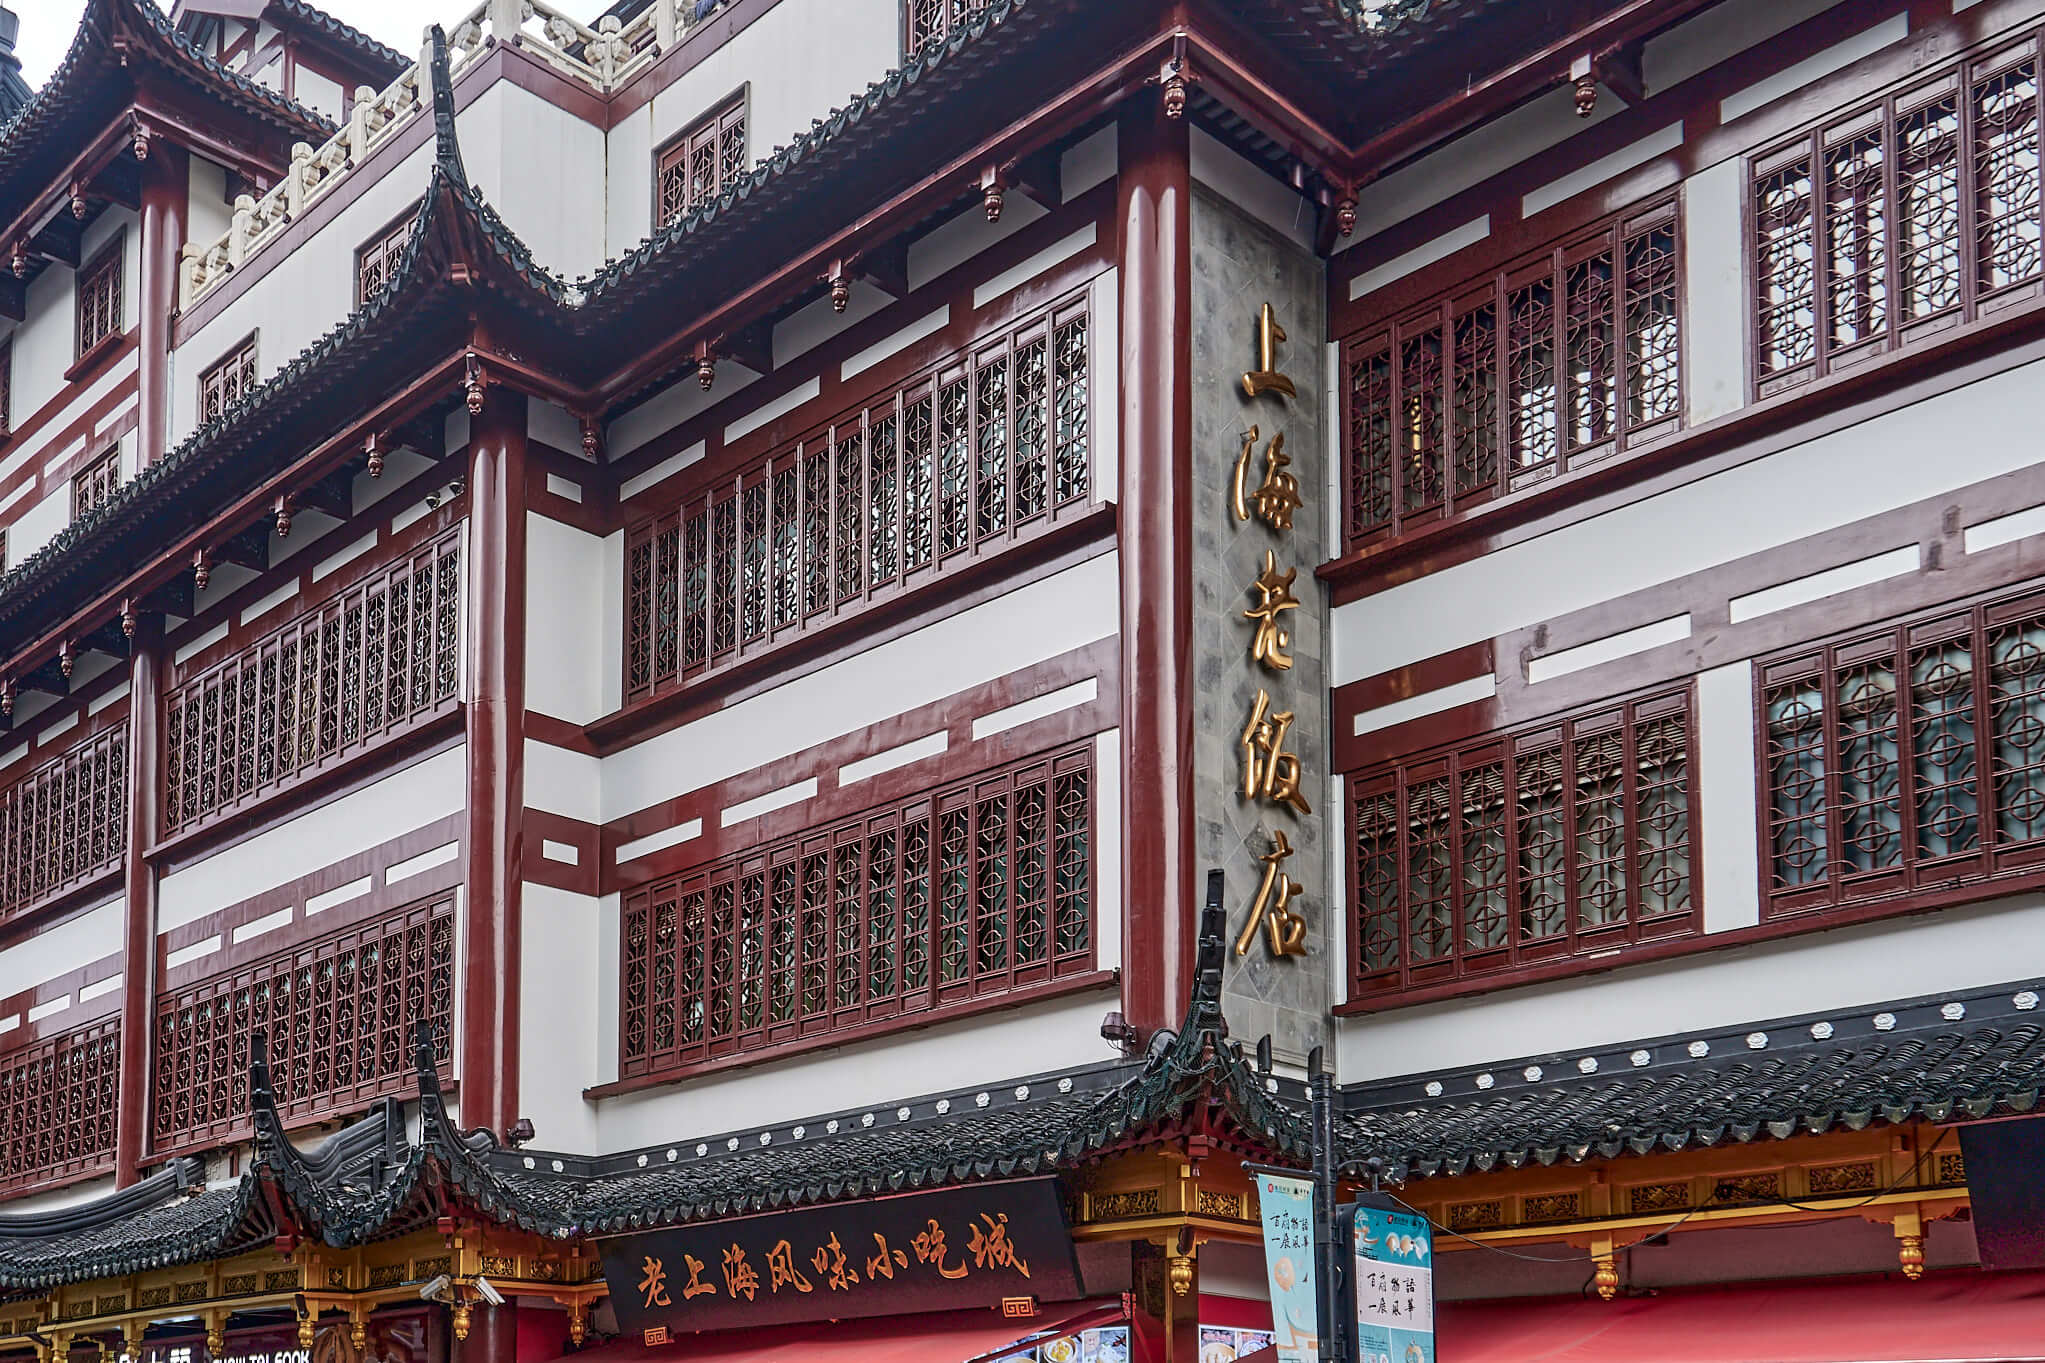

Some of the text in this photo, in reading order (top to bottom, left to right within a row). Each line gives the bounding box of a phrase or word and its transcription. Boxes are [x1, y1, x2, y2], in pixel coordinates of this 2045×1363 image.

[637, 1213, 1031, 1309] 老上海风味小吃城
